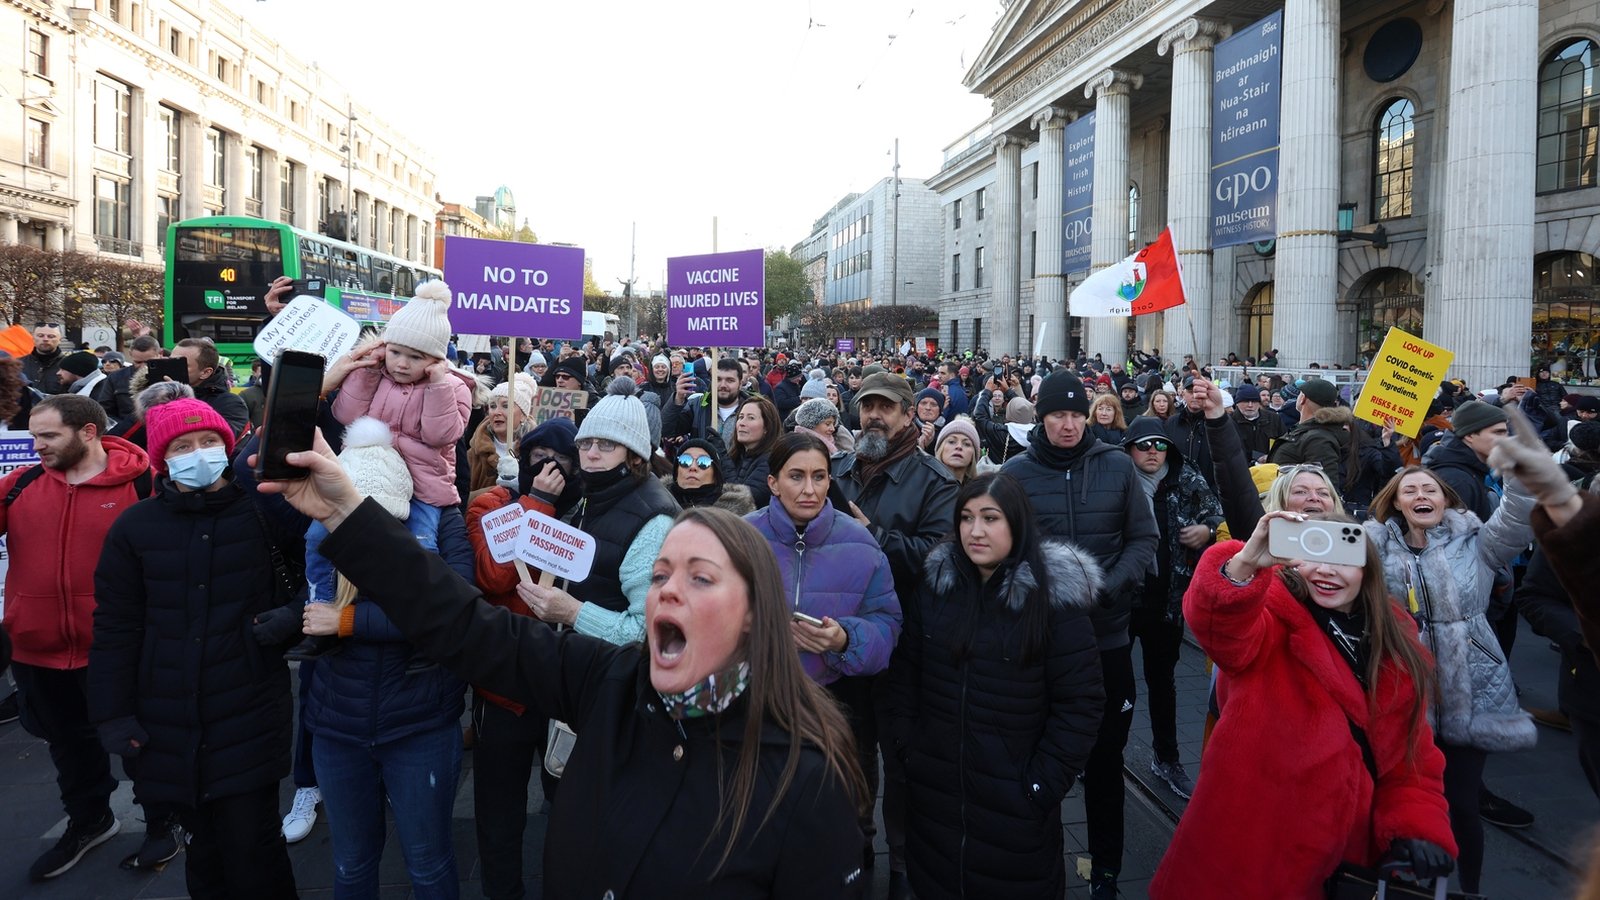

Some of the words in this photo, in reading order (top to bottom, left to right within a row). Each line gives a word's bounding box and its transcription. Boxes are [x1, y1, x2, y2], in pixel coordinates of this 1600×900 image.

[1216, 43, 1277, 83] Breathnaigh
[1238, 75, 1249, 87] ar
[1220, 82, 1270, 112] Nua-Stair
[1236, 108, 1249, 120] na
[1220, 118, 1267, 143] hÉireann
[1069, 135, 1094, 152] Explore
[1068, 150, 1093, 167] Modern
[1073, 167, 1088, 181] Irish
[1068, 182, 1092, 197] History
[1215, 205, 1270, 226] museum
[1215, 223, 1241, 236] WITNESS
[1243, 218, 1270, 231] HISTORY
[220, 268, 235, 282] 40
[484, 266, 516, 284] NO
[521, 269, 548, 286] TO
[686, 267, 739, 285] VACCINE
[207, 296, 223, 304] TFI
[457, 292, 571, 315] MANDATES
[670, 293, 720, 308] INJURED
[724, 291, 758, 307] LIVES
[262, 326, 280, 343] My
[277, 305, 301, 327] First
[266, 334, 287, 357] ever
[287, 303, 319, 336] protest
[687, 316, 738, 331] MATTER
[290, 321, 317, 349] reedom
[320, 321, 342, 352] vaccine
[1402, 341, 1423, 356] LOOK
[1423, 348, 1435, 360] UP
[1386, 355, 1408, 369] COVID
[1409, 365, 1435, 381] Genetic
[1392, 370, 1418, 387] Vaccine
[531, 388, 582, 409] HOOSE
[1380, 379, 1419, 401] Ingredients,
[1370, 395, 1391, 409] RISKS
[1391, 403, 1398, 412] &
[1398, 406, 1415, 419] SIDE
[6, 452, 41, 460] IRELA
[484, 521, 493, 531] NO
[492, 517, 501, 527] TO
[499, 507, 523, 525] VACCINE
[527, 518, 540, 530] NO
[540, 522, 551, 535] TO
[552, 528, 586, 550] VACCINE
[529, 534, 575, 561] PASSPORTS
[522, 549, 547, 565] Freedom
[547, 561, 557, 570] not
[558, 565, 570, 574] fear
